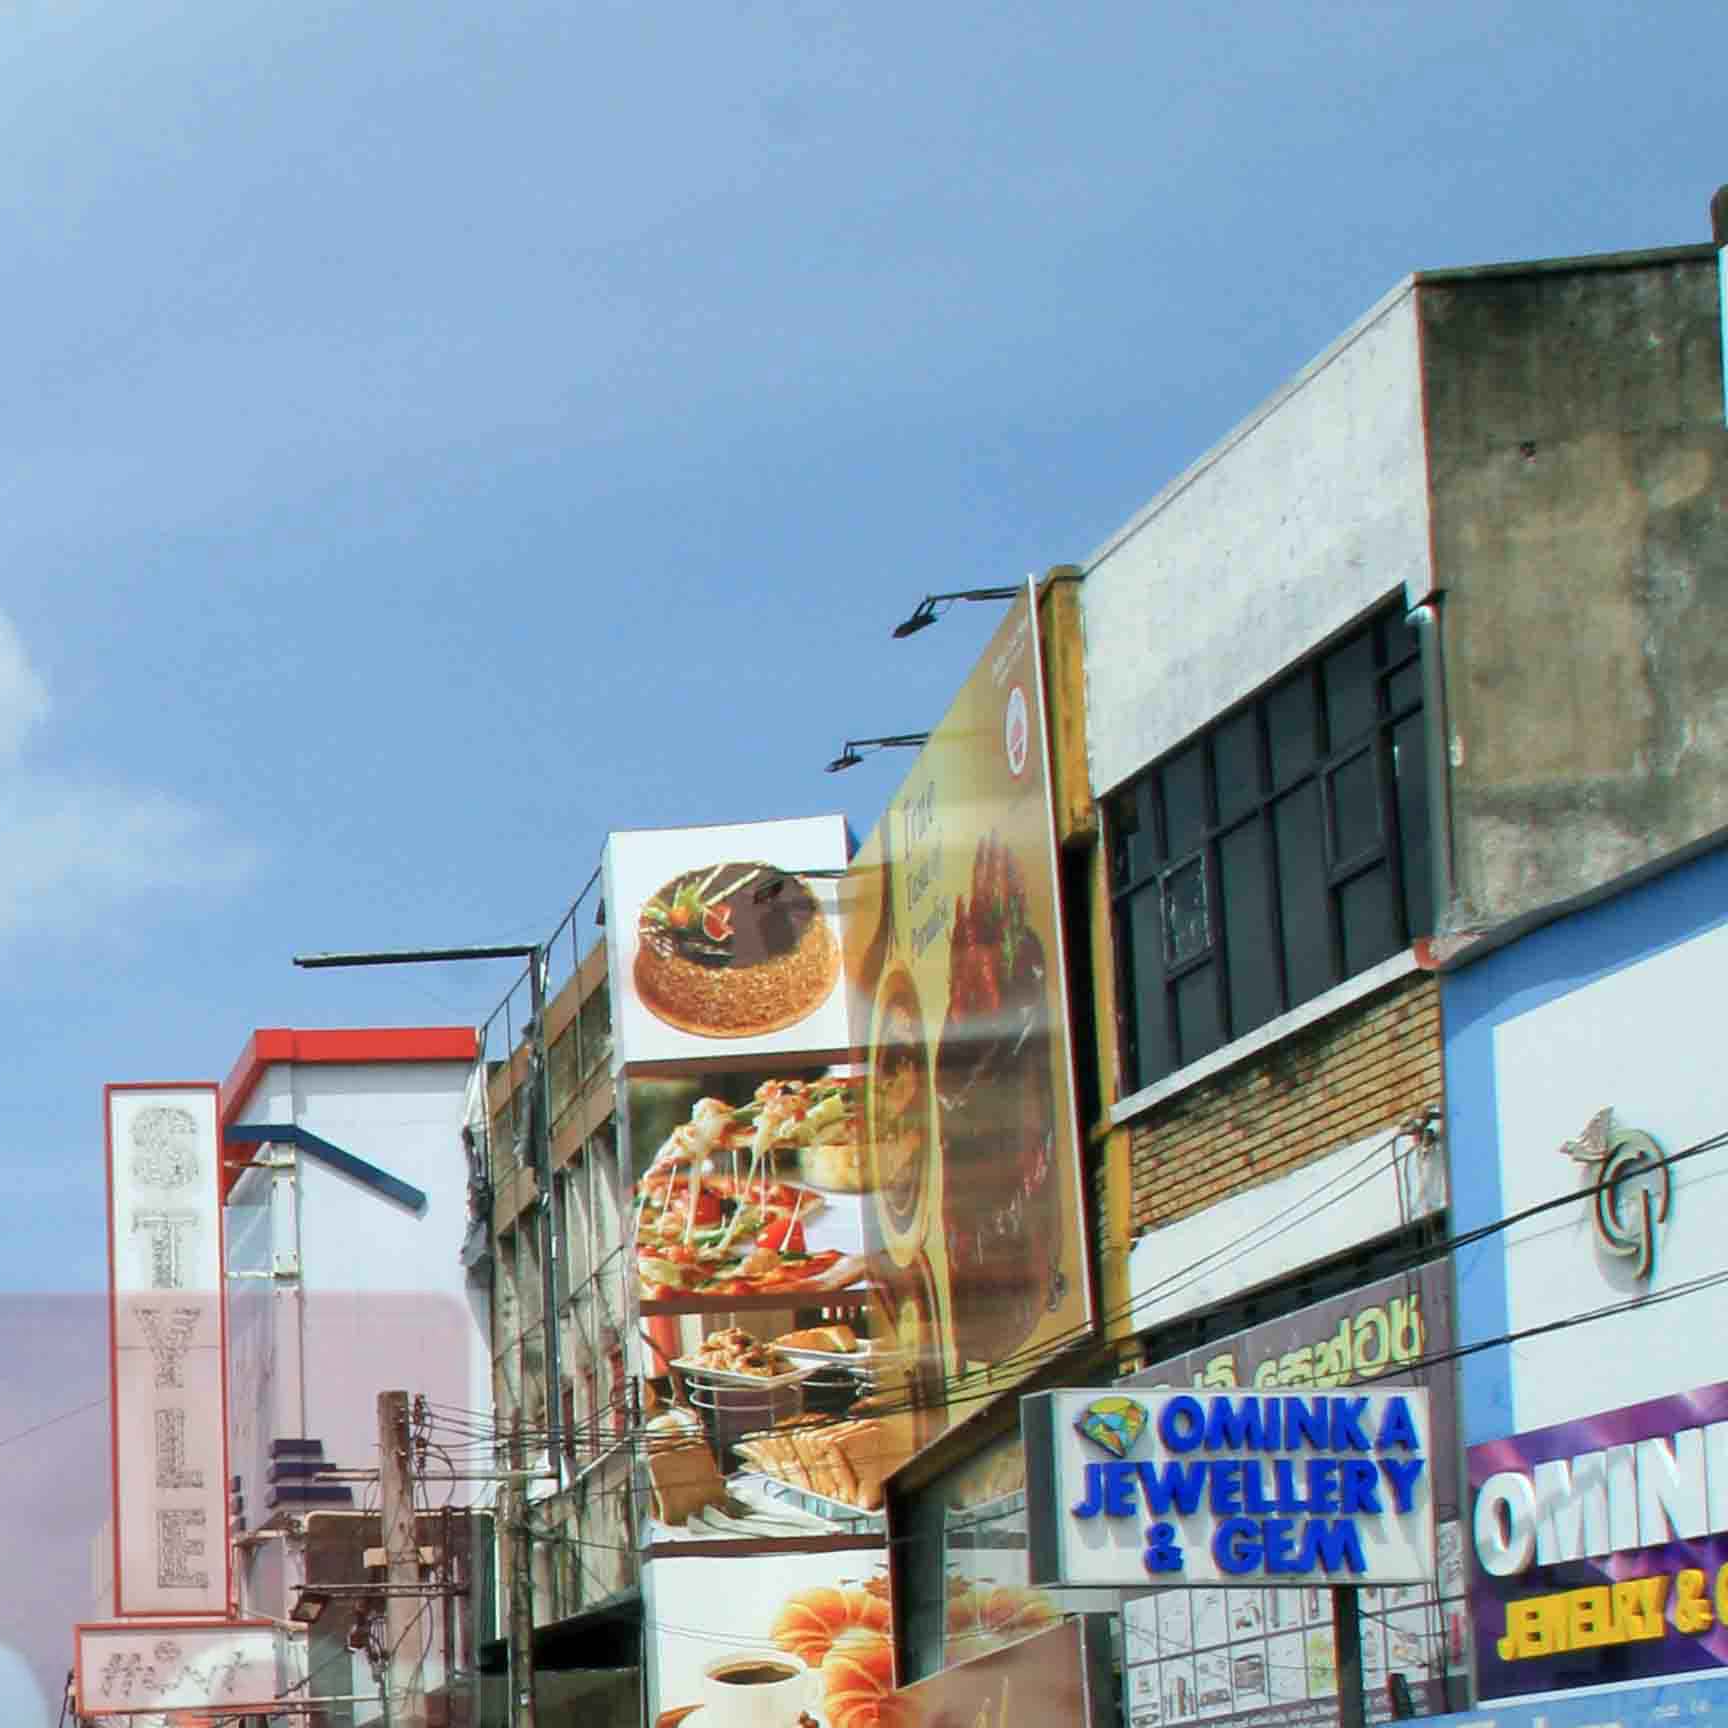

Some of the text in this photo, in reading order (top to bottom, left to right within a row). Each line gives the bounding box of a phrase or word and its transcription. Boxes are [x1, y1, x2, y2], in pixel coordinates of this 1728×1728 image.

[130, 1103, 210, 1591] STYLE
[1158, 1395, 1421, 1453] OMINKA
[1072, 1458, 1426, 1520] JEWELLERY
[1144, 1516, 1367, 1575] & GEM
[1674, 1569, 1713, 1635] &
